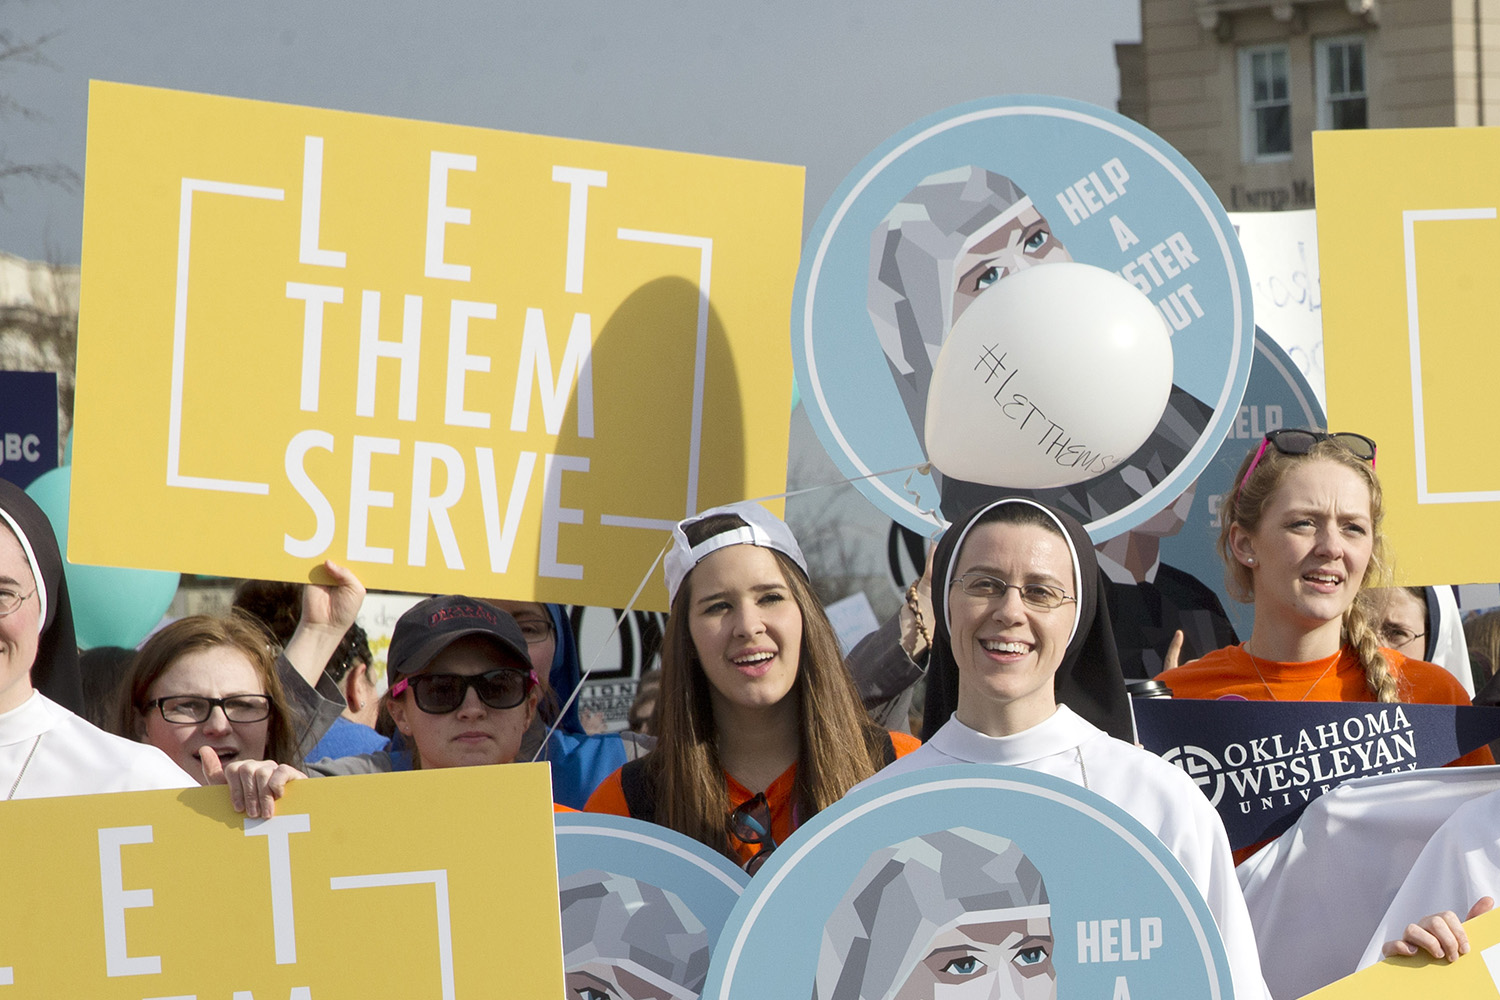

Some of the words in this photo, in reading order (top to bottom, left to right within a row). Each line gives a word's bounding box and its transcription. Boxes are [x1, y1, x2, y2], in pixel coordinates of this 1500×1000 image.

[299, 136, 607, 293] LET
[1056, 157, 1130, 226] HELP
[1109, 215, 1140, 252] A
[1115, 231, 1200, 296] STER
[1156, 283, 1205, 337] UT
[286, 282, 594, 438] THEM
[284, 430, 590, 580] SERVE
[1224, 705, 1411, 767] OKLAHOMA
[1227, 730, 1418, 798] WESLEYAN
[1239, 762, 1418, 814] UNIVETY
[0, 814, 310, 986] ET
[1077, 917, 1163, 963] HELP
